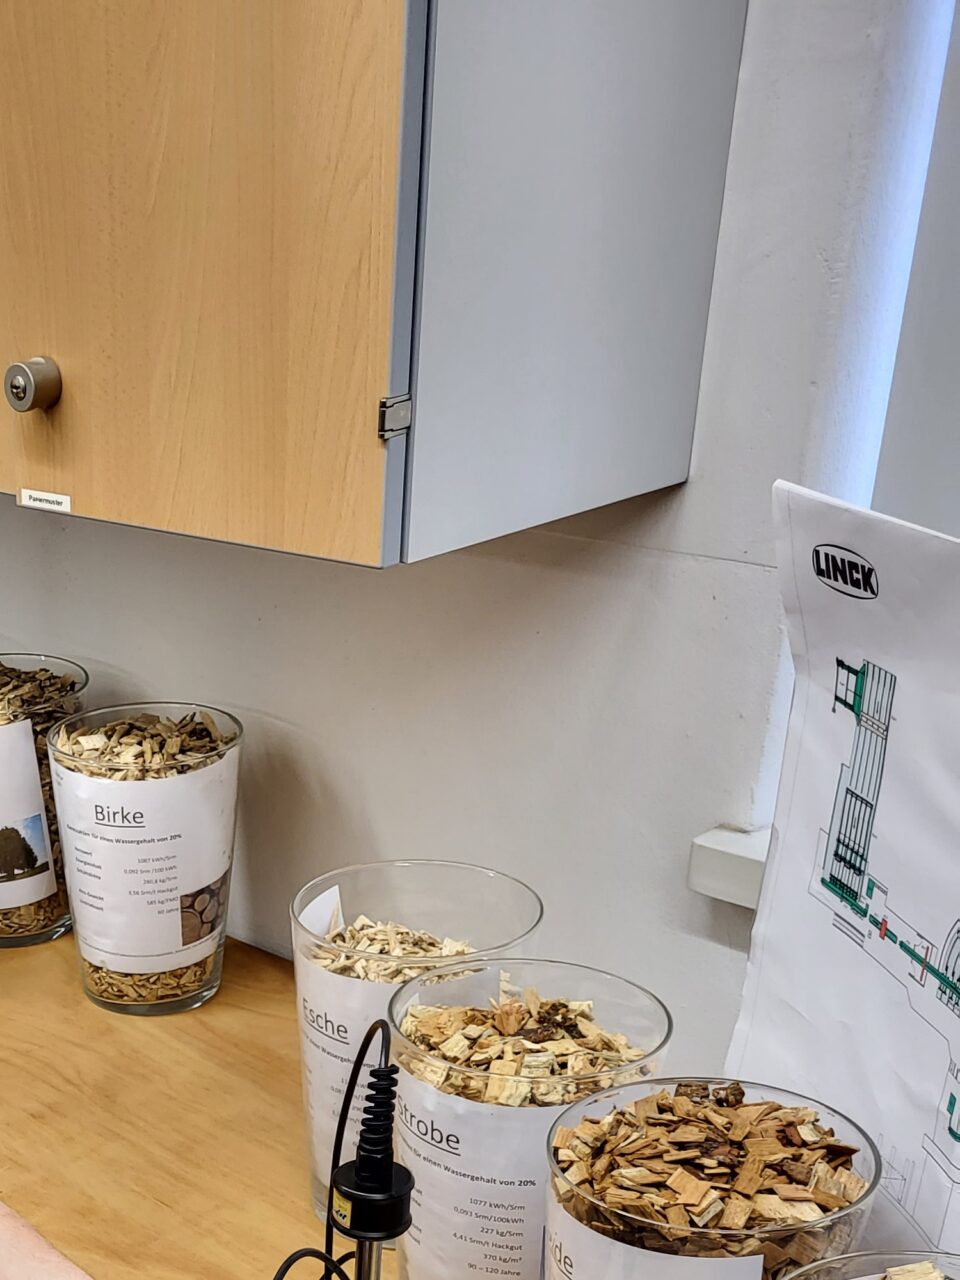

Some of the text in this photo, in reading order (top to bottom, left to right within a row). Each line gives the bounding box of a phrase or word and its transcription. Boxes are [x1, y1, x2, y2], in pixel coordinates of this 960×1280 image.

[814, 548, 878, 597] LINCK
[94, 804, 144, 824] Birke
[115, 837, 156, 846] Wassergehalt
[302, 997, 348, 1040] Esche
[397, 1094, 461, 1151] Strobe
[422, 1156, 442, 1169] einen
[443, 1164, 497, 1186] Wassergehalt
[498, 1178, 516, 1186] von
[517, 1179, 537, 1187] 20%
[469, 1197, 525, 1211] 1077 kWh/Srm
[474, 1212, 525, 1224] Srm/100kWh
[480, 1226, 524, 1238] 227 kg/Srm
[491, 1242, 523, 1251] Hackgut
[549, 1231, 574, 1275] ide
[483, 1253, 497, 1261] 370
[485, 1266, 499, 1274] 120
[500, 1267, 521, 1276] Jahre
